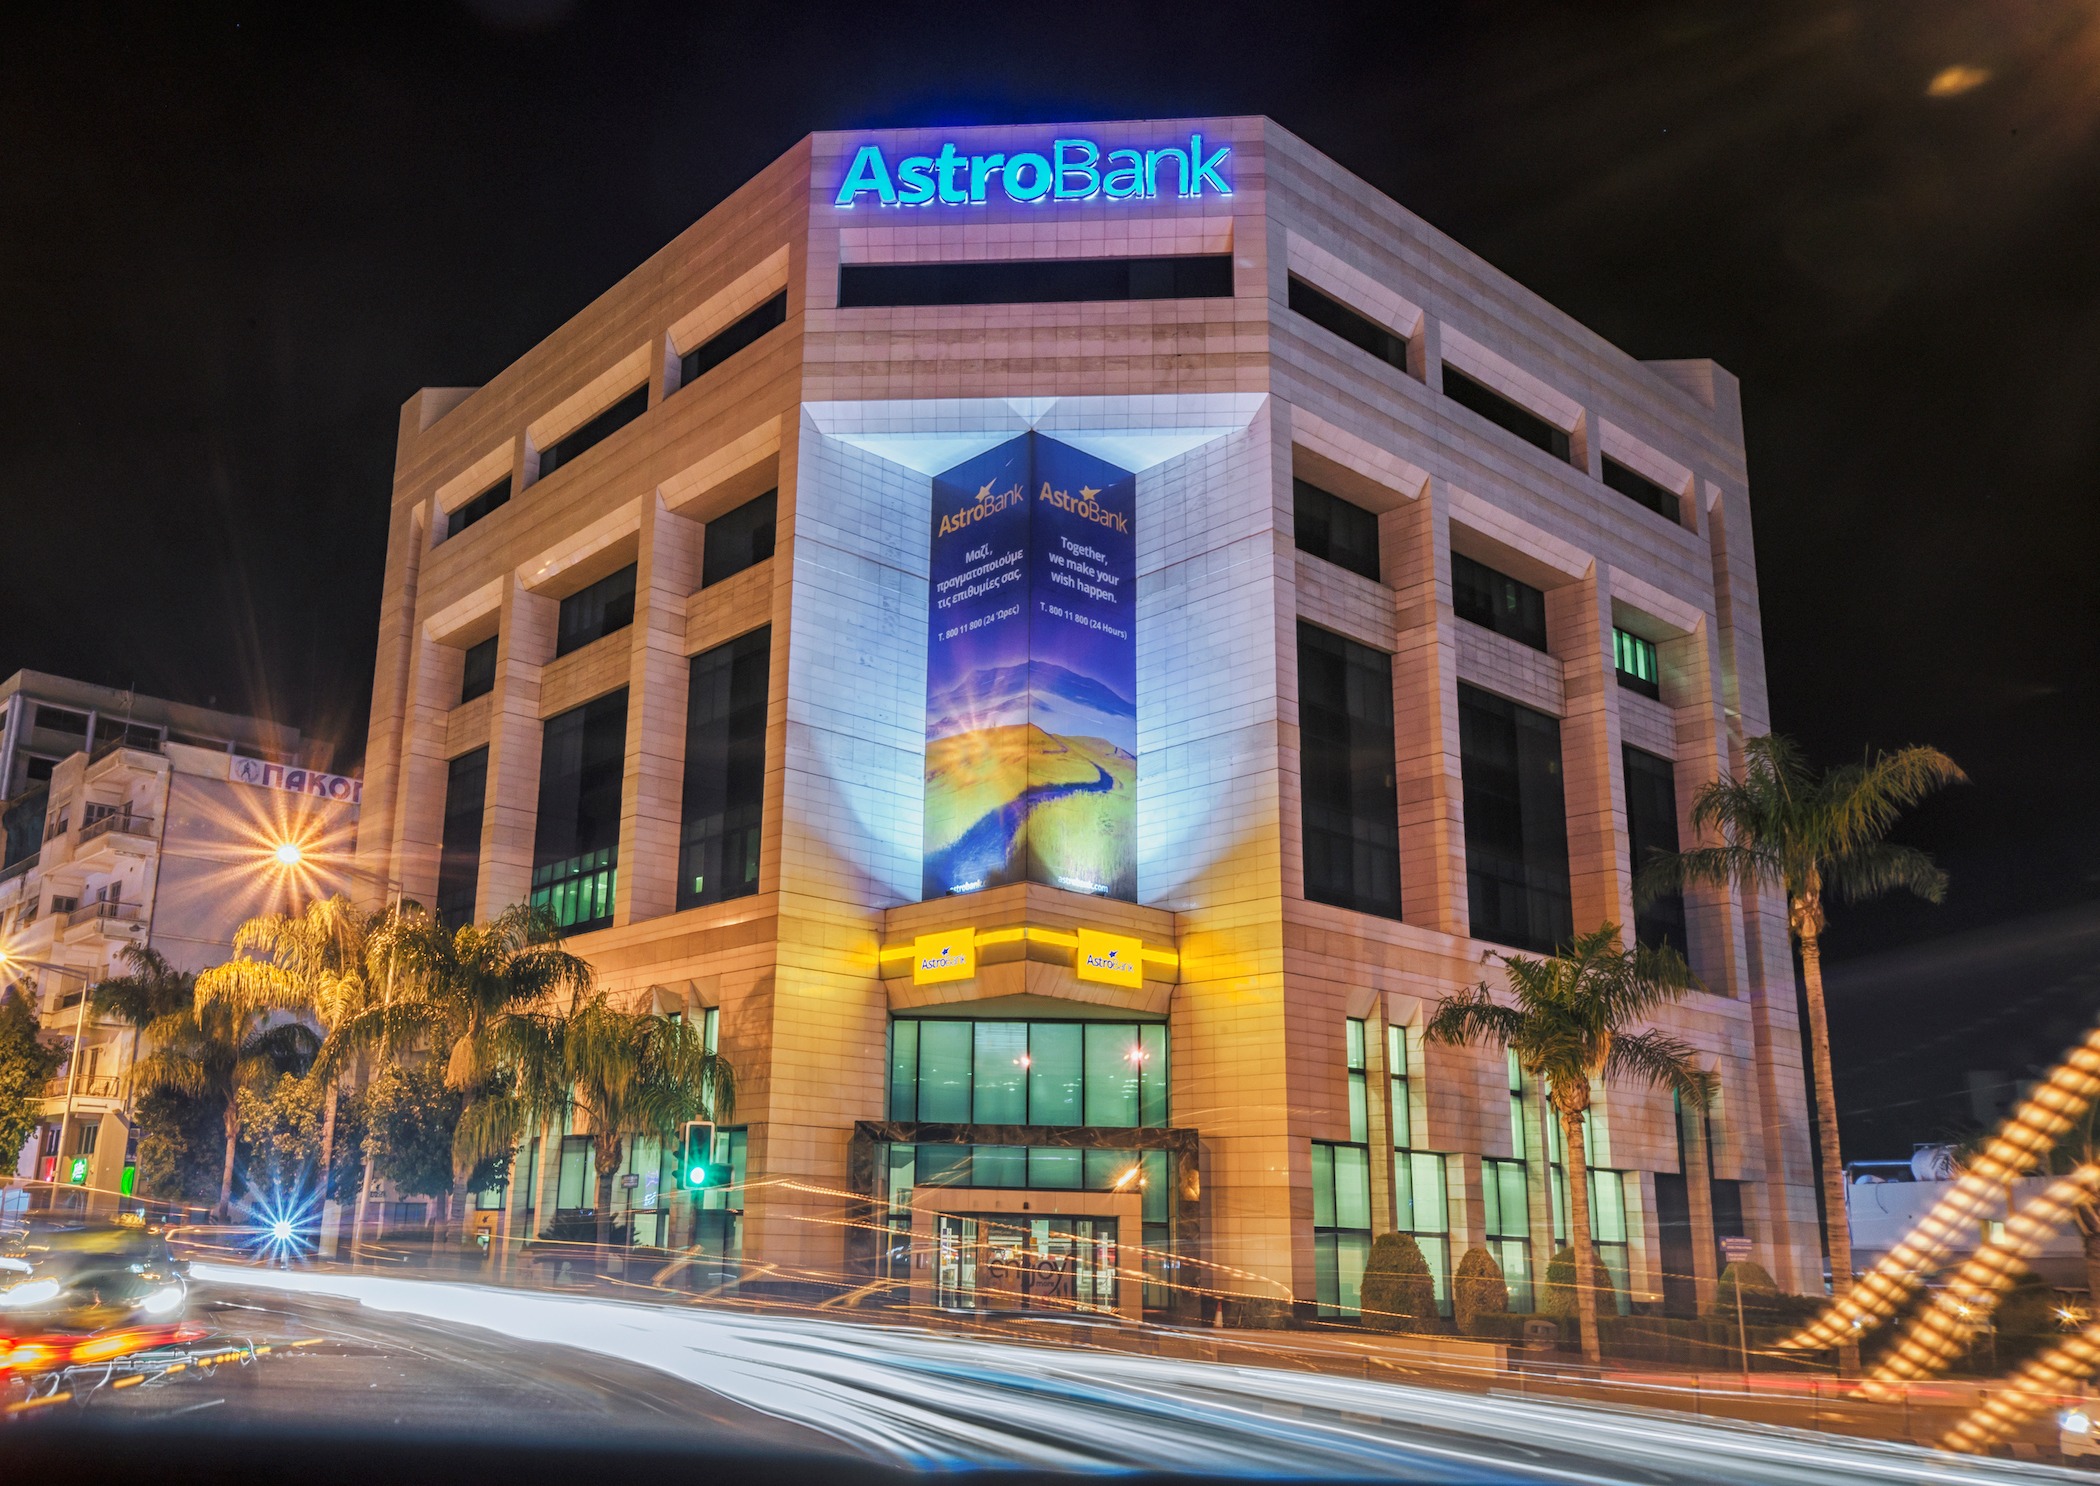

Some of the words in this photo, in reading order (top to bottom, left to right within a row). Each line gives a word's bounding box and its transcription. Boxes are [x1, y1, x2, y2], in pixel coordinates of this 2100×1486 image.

[834, 134, 1233, 207] AstroBank
[938, 483, 1024, 538] AstroBank
[1039, 481, 1128, 535] AstroBank
[965, 543, 993, 564] Μαζί,
[1061, 536, 1109, 567] Together,
[936, 548, 1024, 593] πραγματοποιούμε
[1048, 552, 1065, 567] we
[1066, 558, 1095, 578] make
[1096, 568, 1120, 587] your
[937, 594, 952, 610] τις
[952, 577, 1000, 604] επιθυμίες
[1001, 567, 1022, 585] σας.
[1050, 571, 1075, 589] wish
[1077, 578, 1117, 604] happen.
[945, 627, 959, 640] 800
[959, 622, 969, 635] 11
[969, 618, 983, 631] 800
[983, 611, 996, 627] (24
[1040, 602, 1048, 613] T.
[1049, 604, 1063, 618] 800
[1064, 608, 1073, 621] 11
[1074, 612, 1089, 626] 800
[1089, 618, 1102, 632] (24
[1102, 622, 1128, 640] Hours)
[921, 954, 967, 971] AstroBank
[1086, 954, 1135, 973] AstroBank
